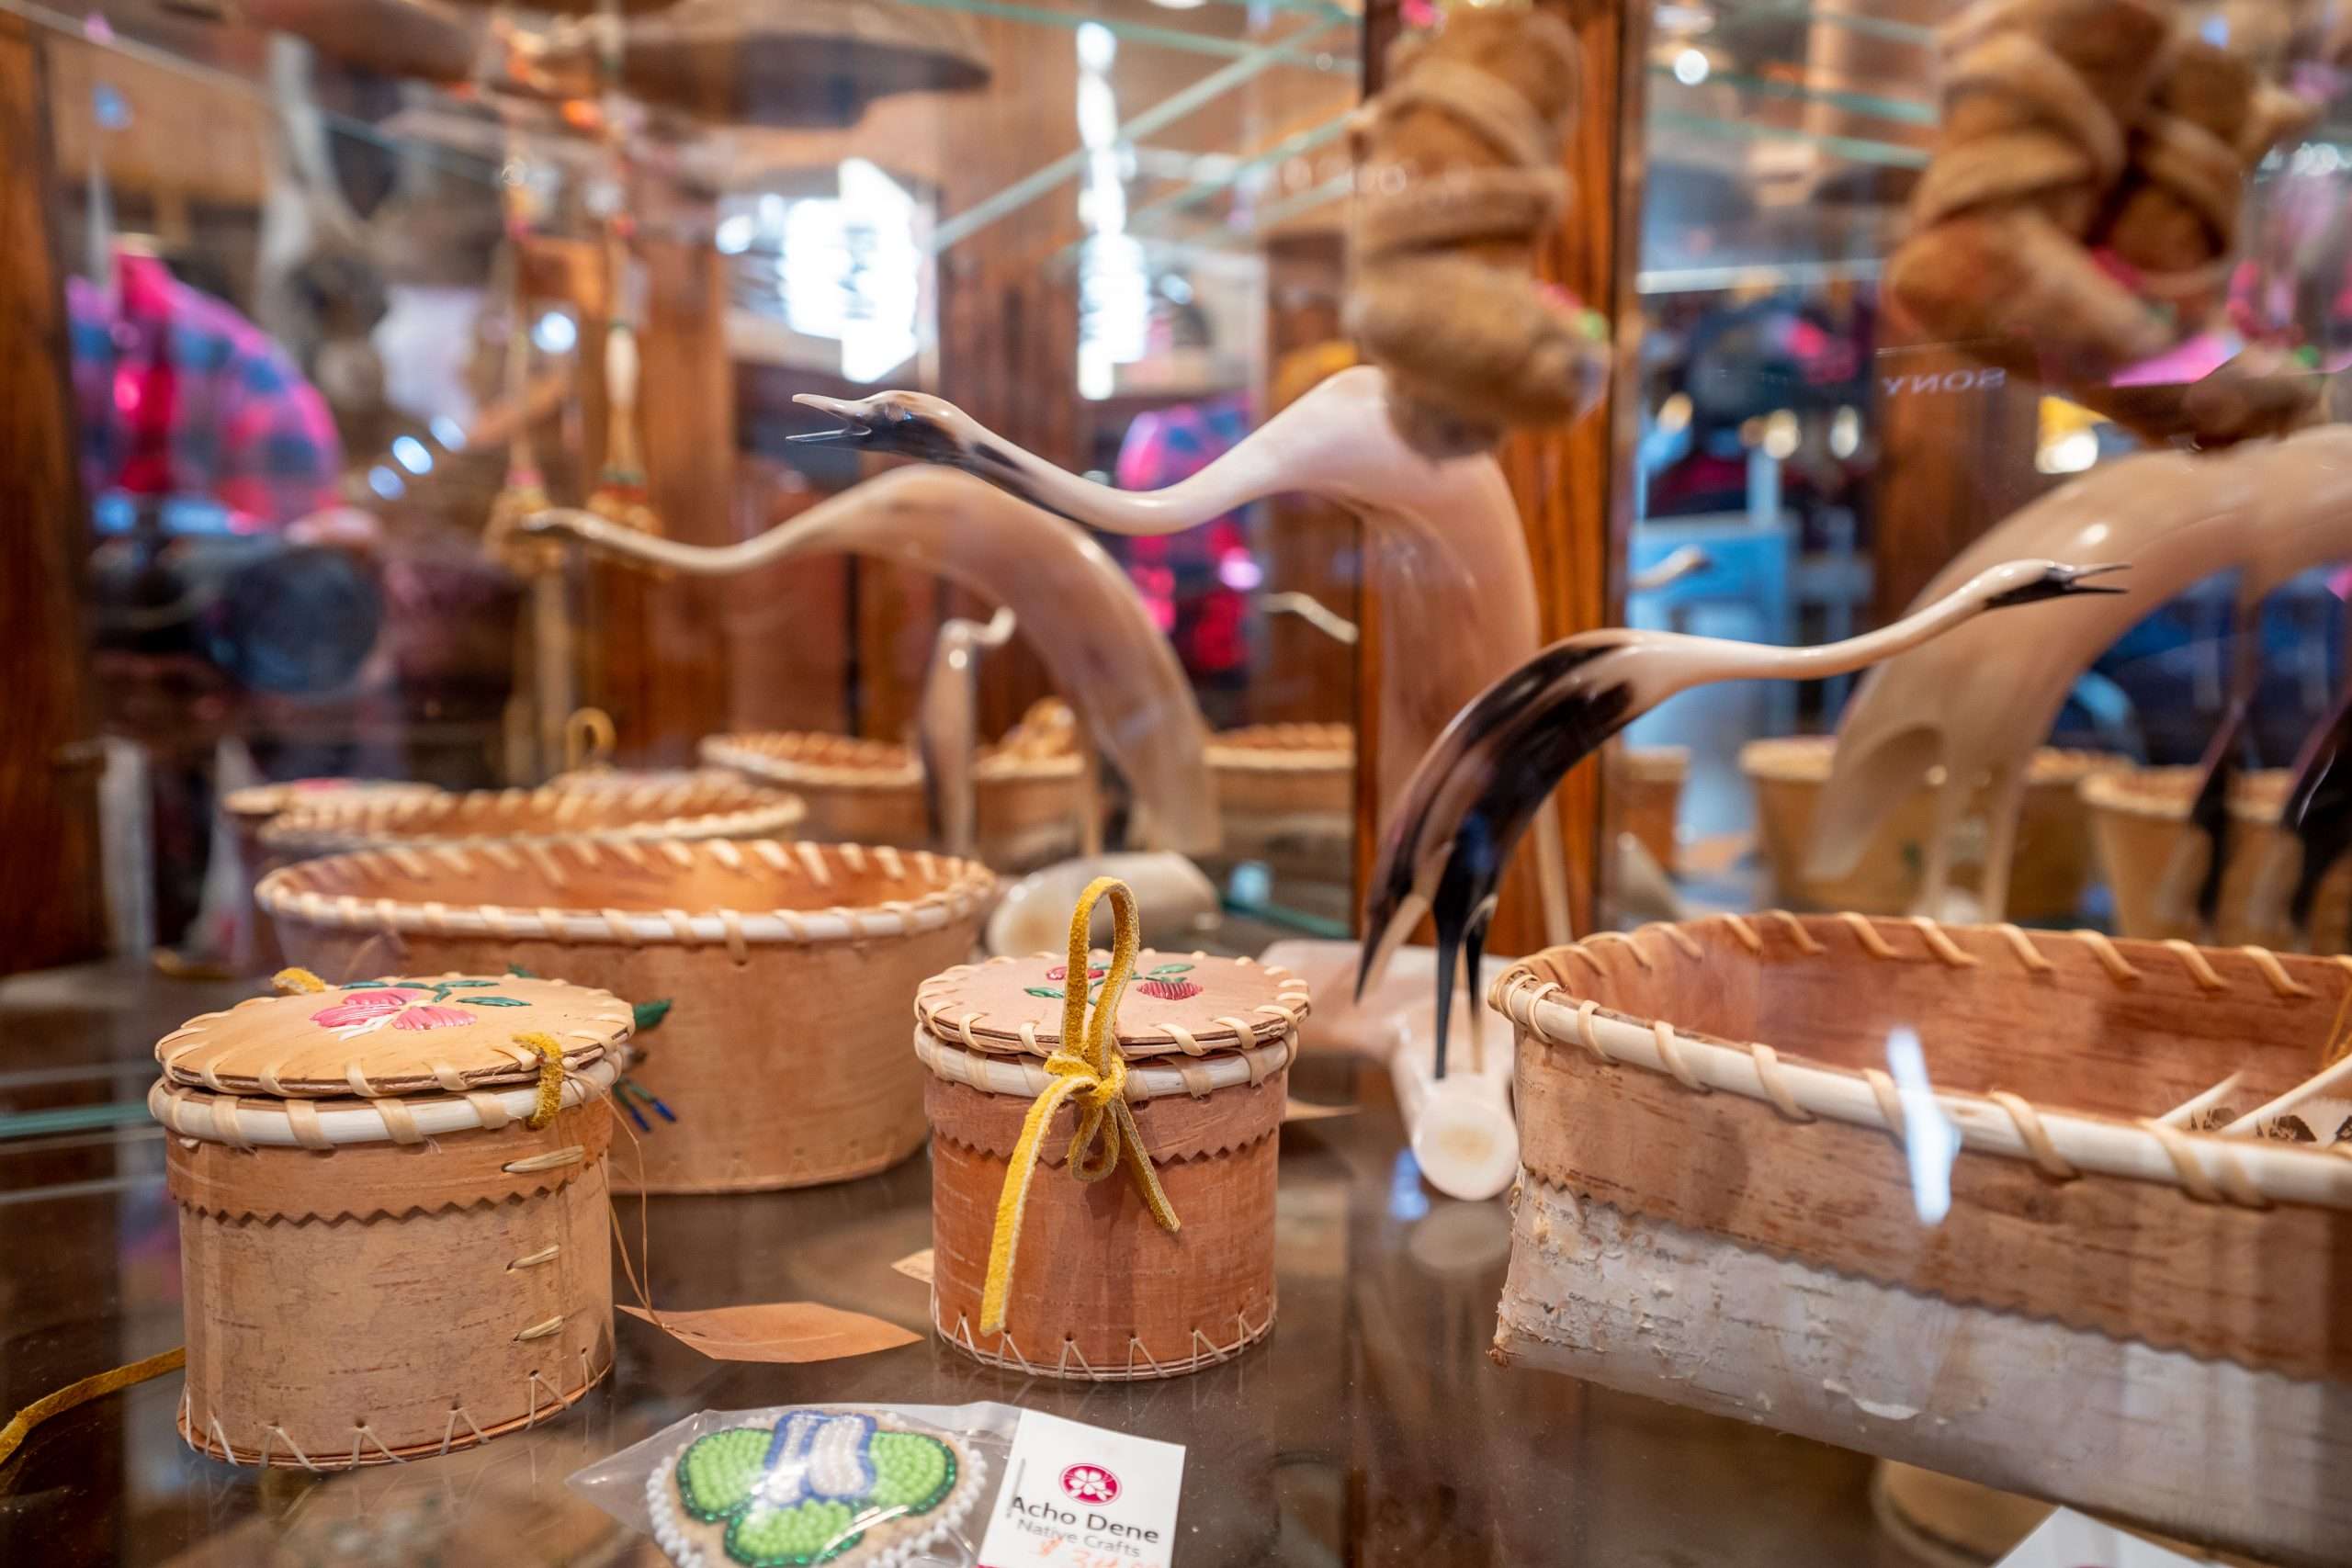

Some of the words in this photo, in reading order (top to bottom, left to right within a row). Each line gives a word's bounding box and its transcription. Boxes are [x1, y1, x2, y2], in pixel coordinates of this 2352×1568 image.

[1012, 1496, 1077, 1525] Acho
[1087, 1514, 1159, 1544] Dene
[1017, 1518, 1079, 1544] Native
[1083, 1535, 1141, 1558] Crafts
